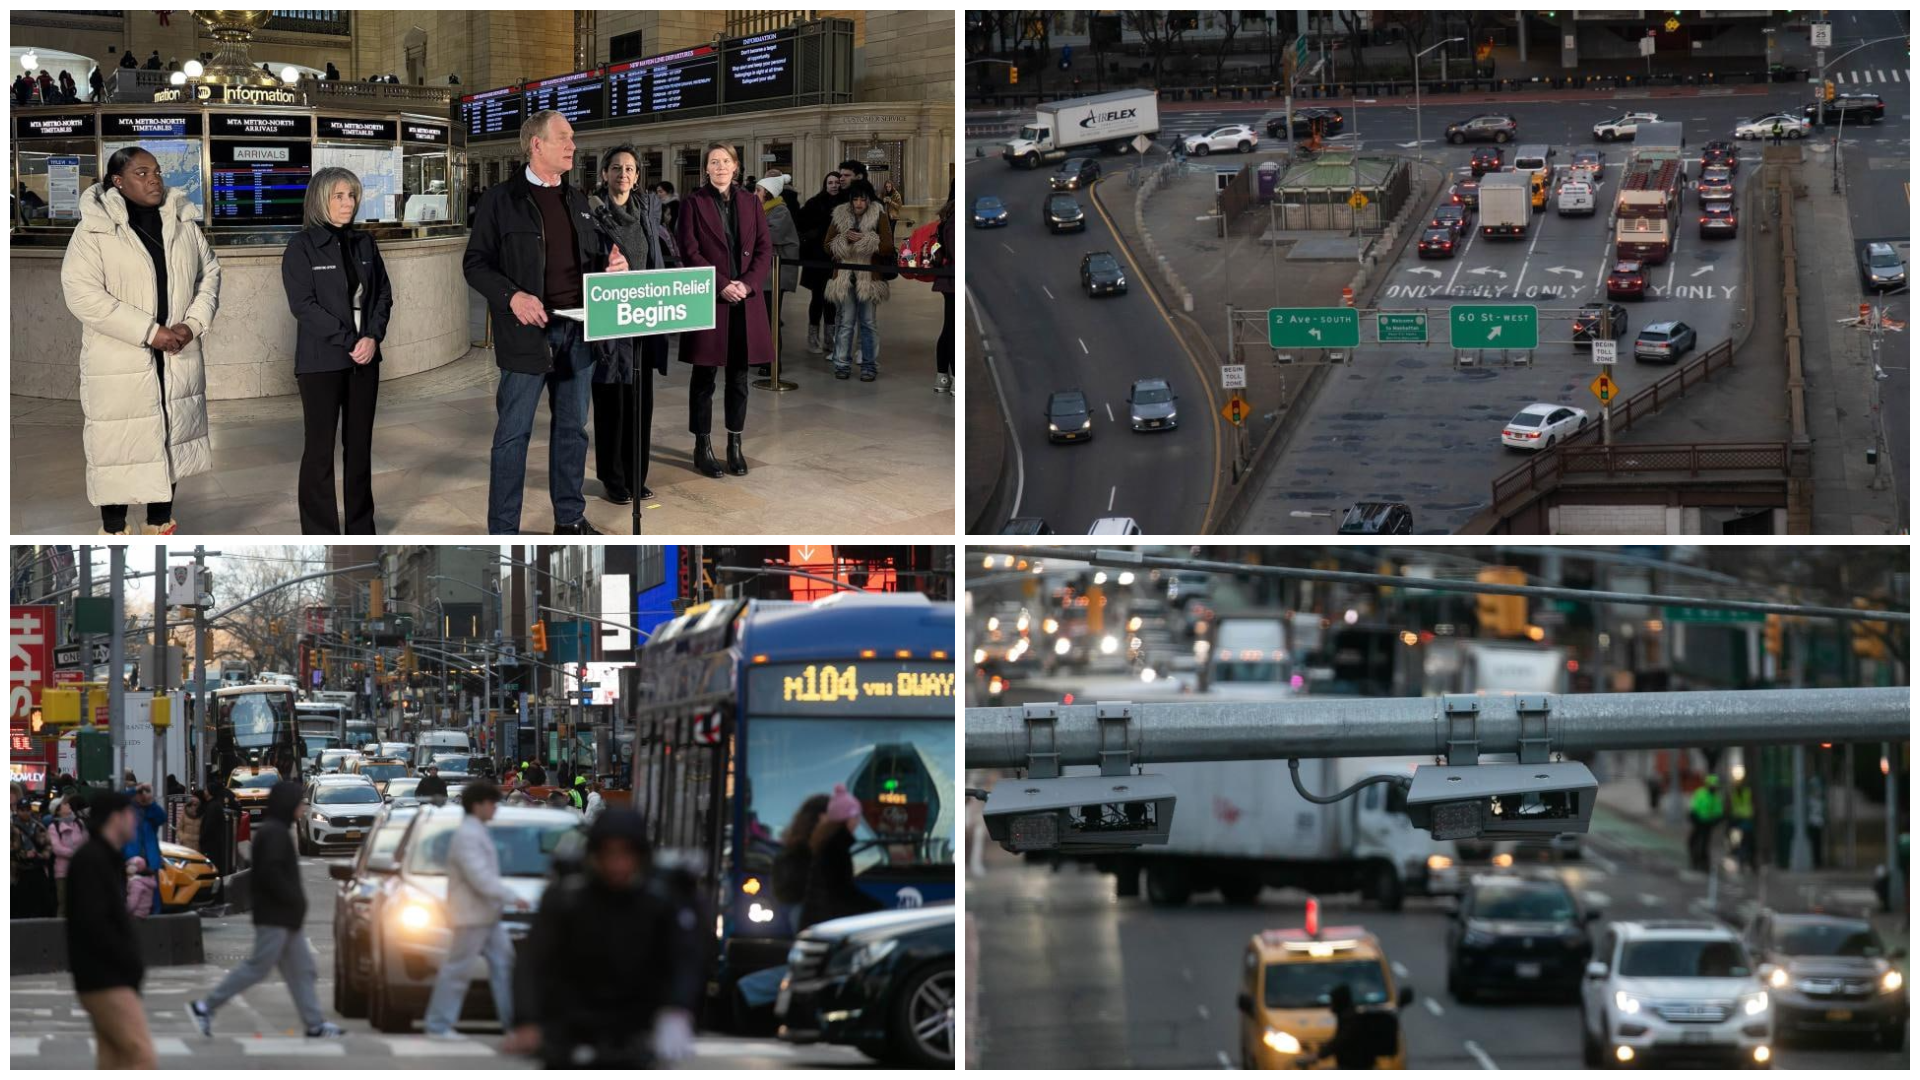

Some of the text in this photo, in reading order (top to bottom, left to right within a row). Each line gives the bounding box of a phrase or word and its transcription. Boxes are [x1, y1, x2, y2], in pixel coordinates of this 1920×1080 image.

[224, 84, 295, 102] Information
[237, 150, 286, 159] ARRIVALS
[590, 279, 710, 302] Congestion Relief
[1386, 284, 1444, 298] ONLY
[1452, 284, 1508, 298] ONLY
[1526, 284, 1586, 298] ONLY
[1676, 285, 1737, 299] ONLY
[617, 300, 687, 327] Begins
[1276, 315, 1284, 324] 2
[1290, 315, 1311, 323] Ave
[1458, 313, 1474, 322] 60
[1481, 313, 1493, 322] St
[784, 665, 858, 701] M104
